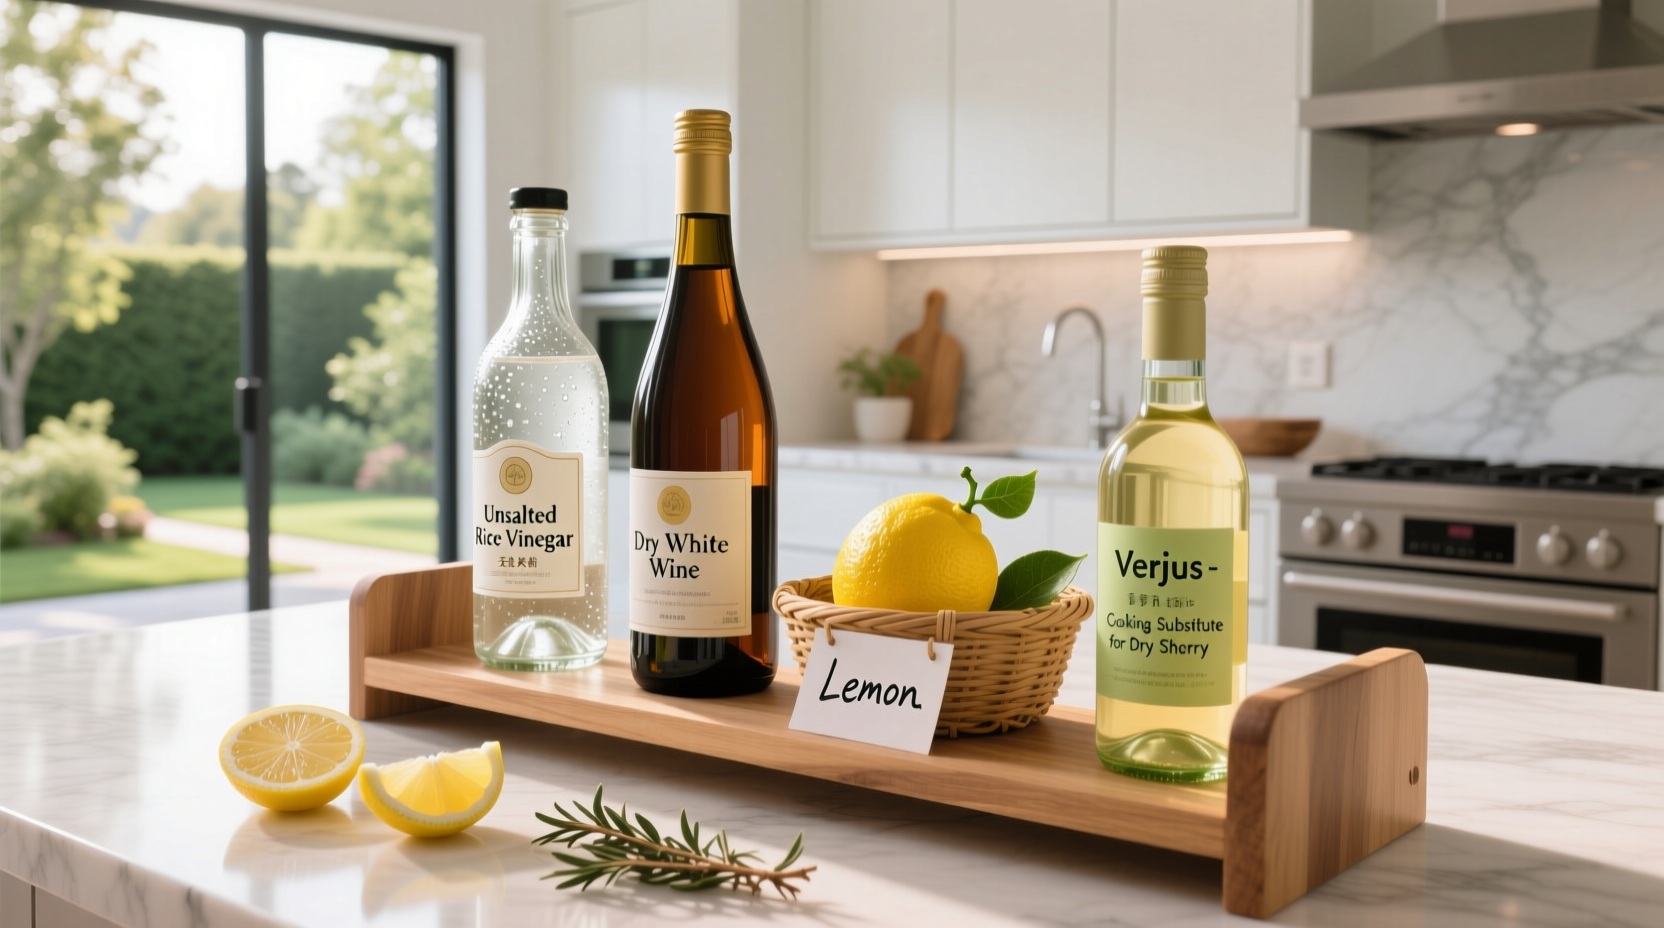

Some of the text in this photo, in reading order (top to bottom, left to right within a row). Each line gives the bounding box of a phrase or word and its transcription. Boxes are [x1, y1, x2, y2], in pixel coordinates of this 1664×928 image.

[484, 504, 557, 524] Unsalted
[475, 526, 574, 553] Rice Vinegar
[634, 530, 729, 557] Dry White
[649, 557, 700, 579] Wine
[1115, 549, 1203, 587] Verjus
[1109, 634, 1127, 650] for
[1130, 636, 1154, 658] Dry
[819, 657, 922, 710] Lemon
